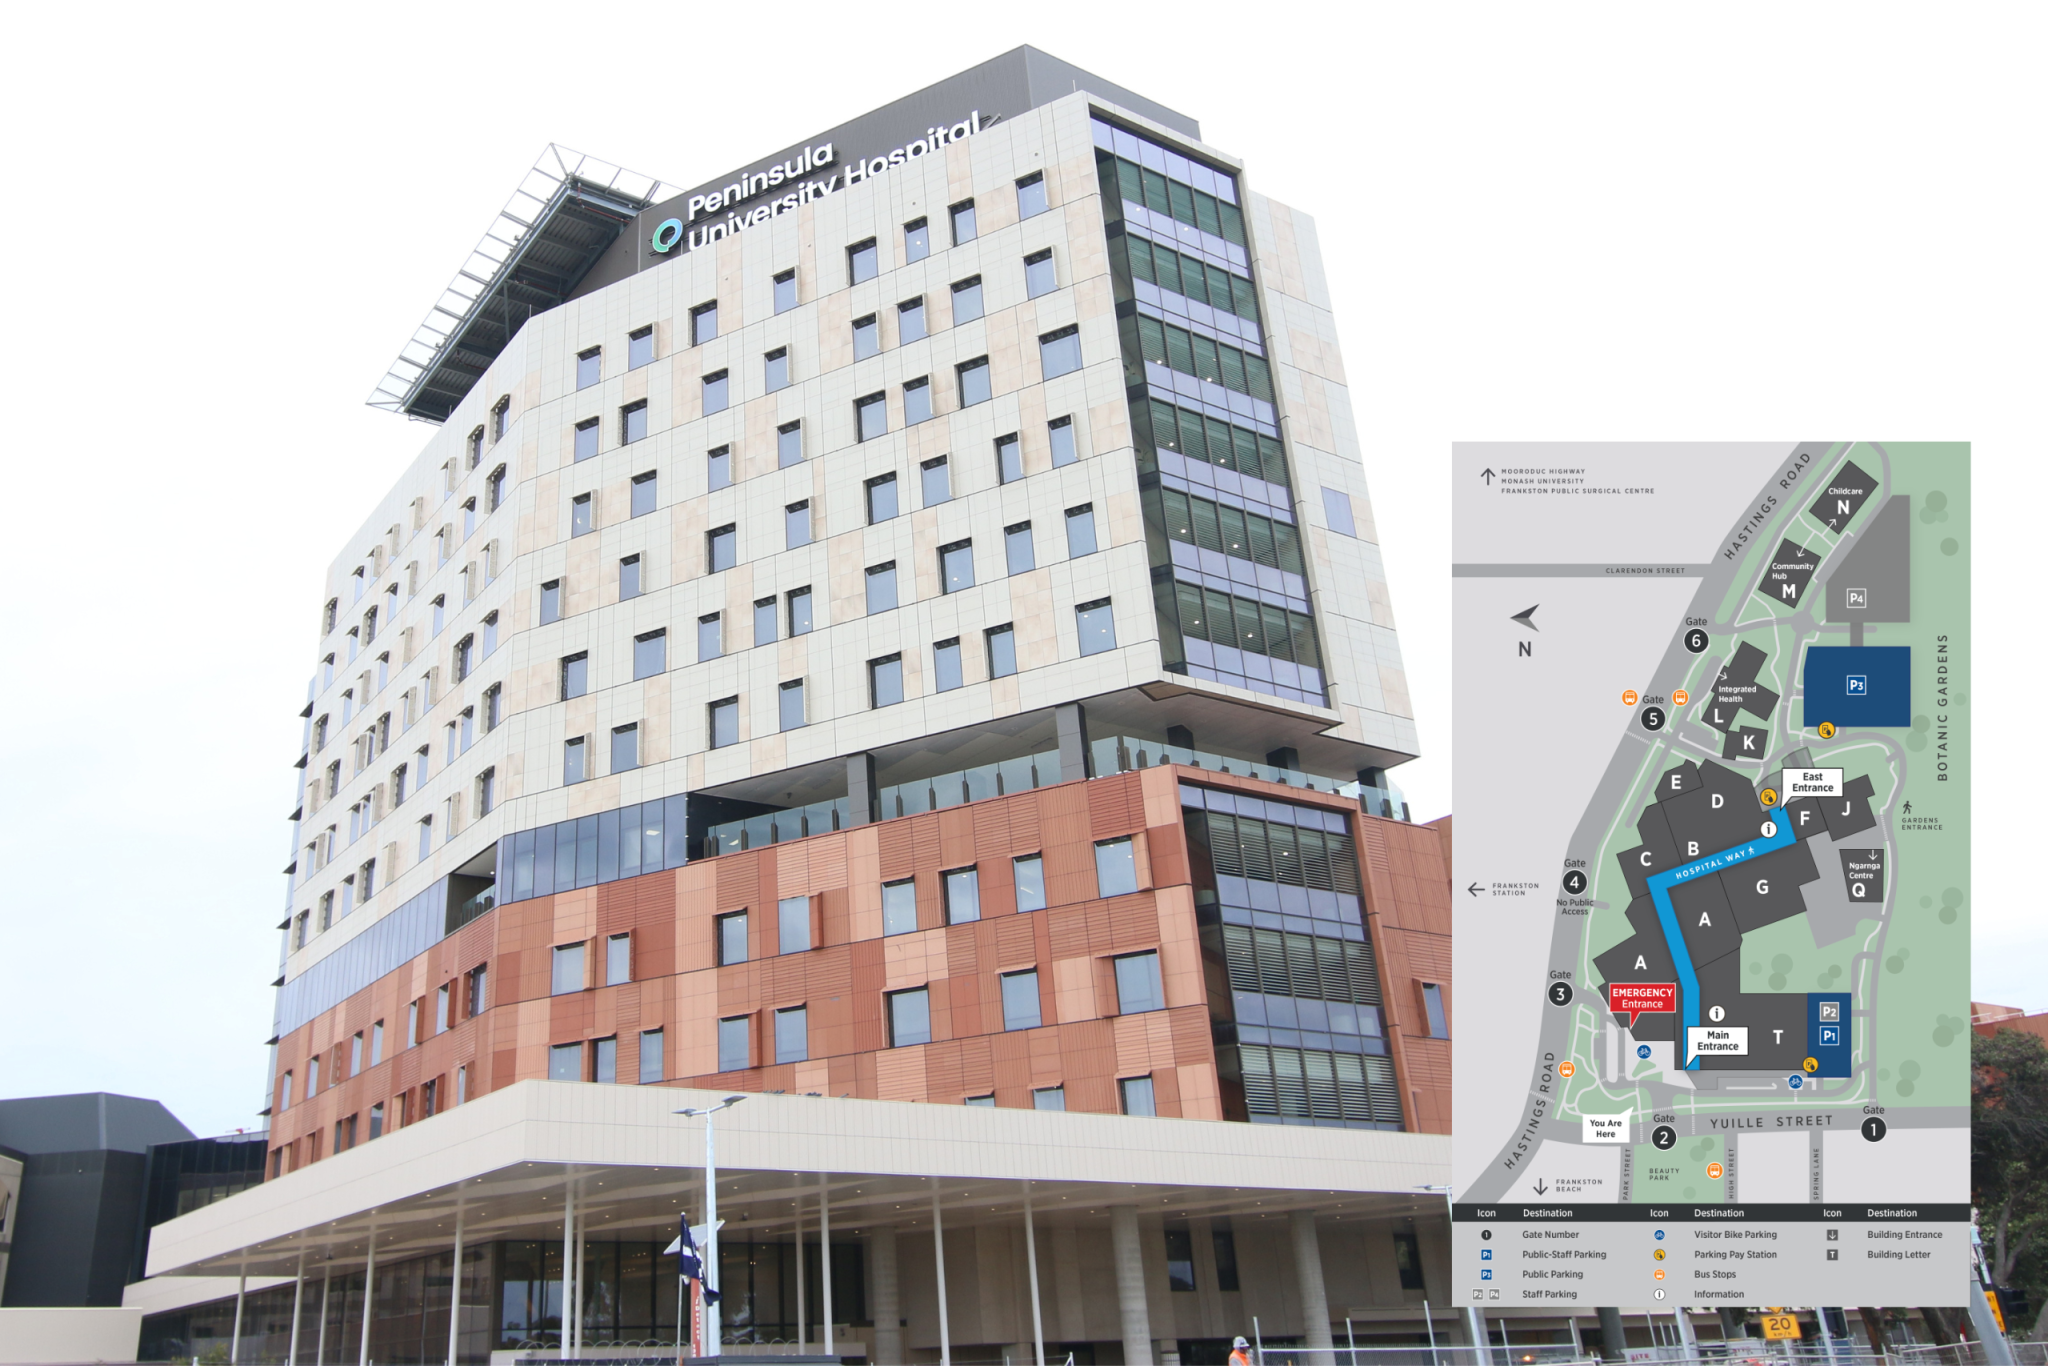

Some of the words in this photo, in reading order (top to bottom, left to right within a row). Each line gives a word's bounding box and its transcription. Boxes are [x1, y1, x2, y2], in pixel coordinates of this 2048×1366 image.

[688, 174, 837, 250] University
[844, 110, 980, 187] Hospital
[688, 142, 833, 221] Peninsula
[1768, 1317, 1791, 1331] 20
